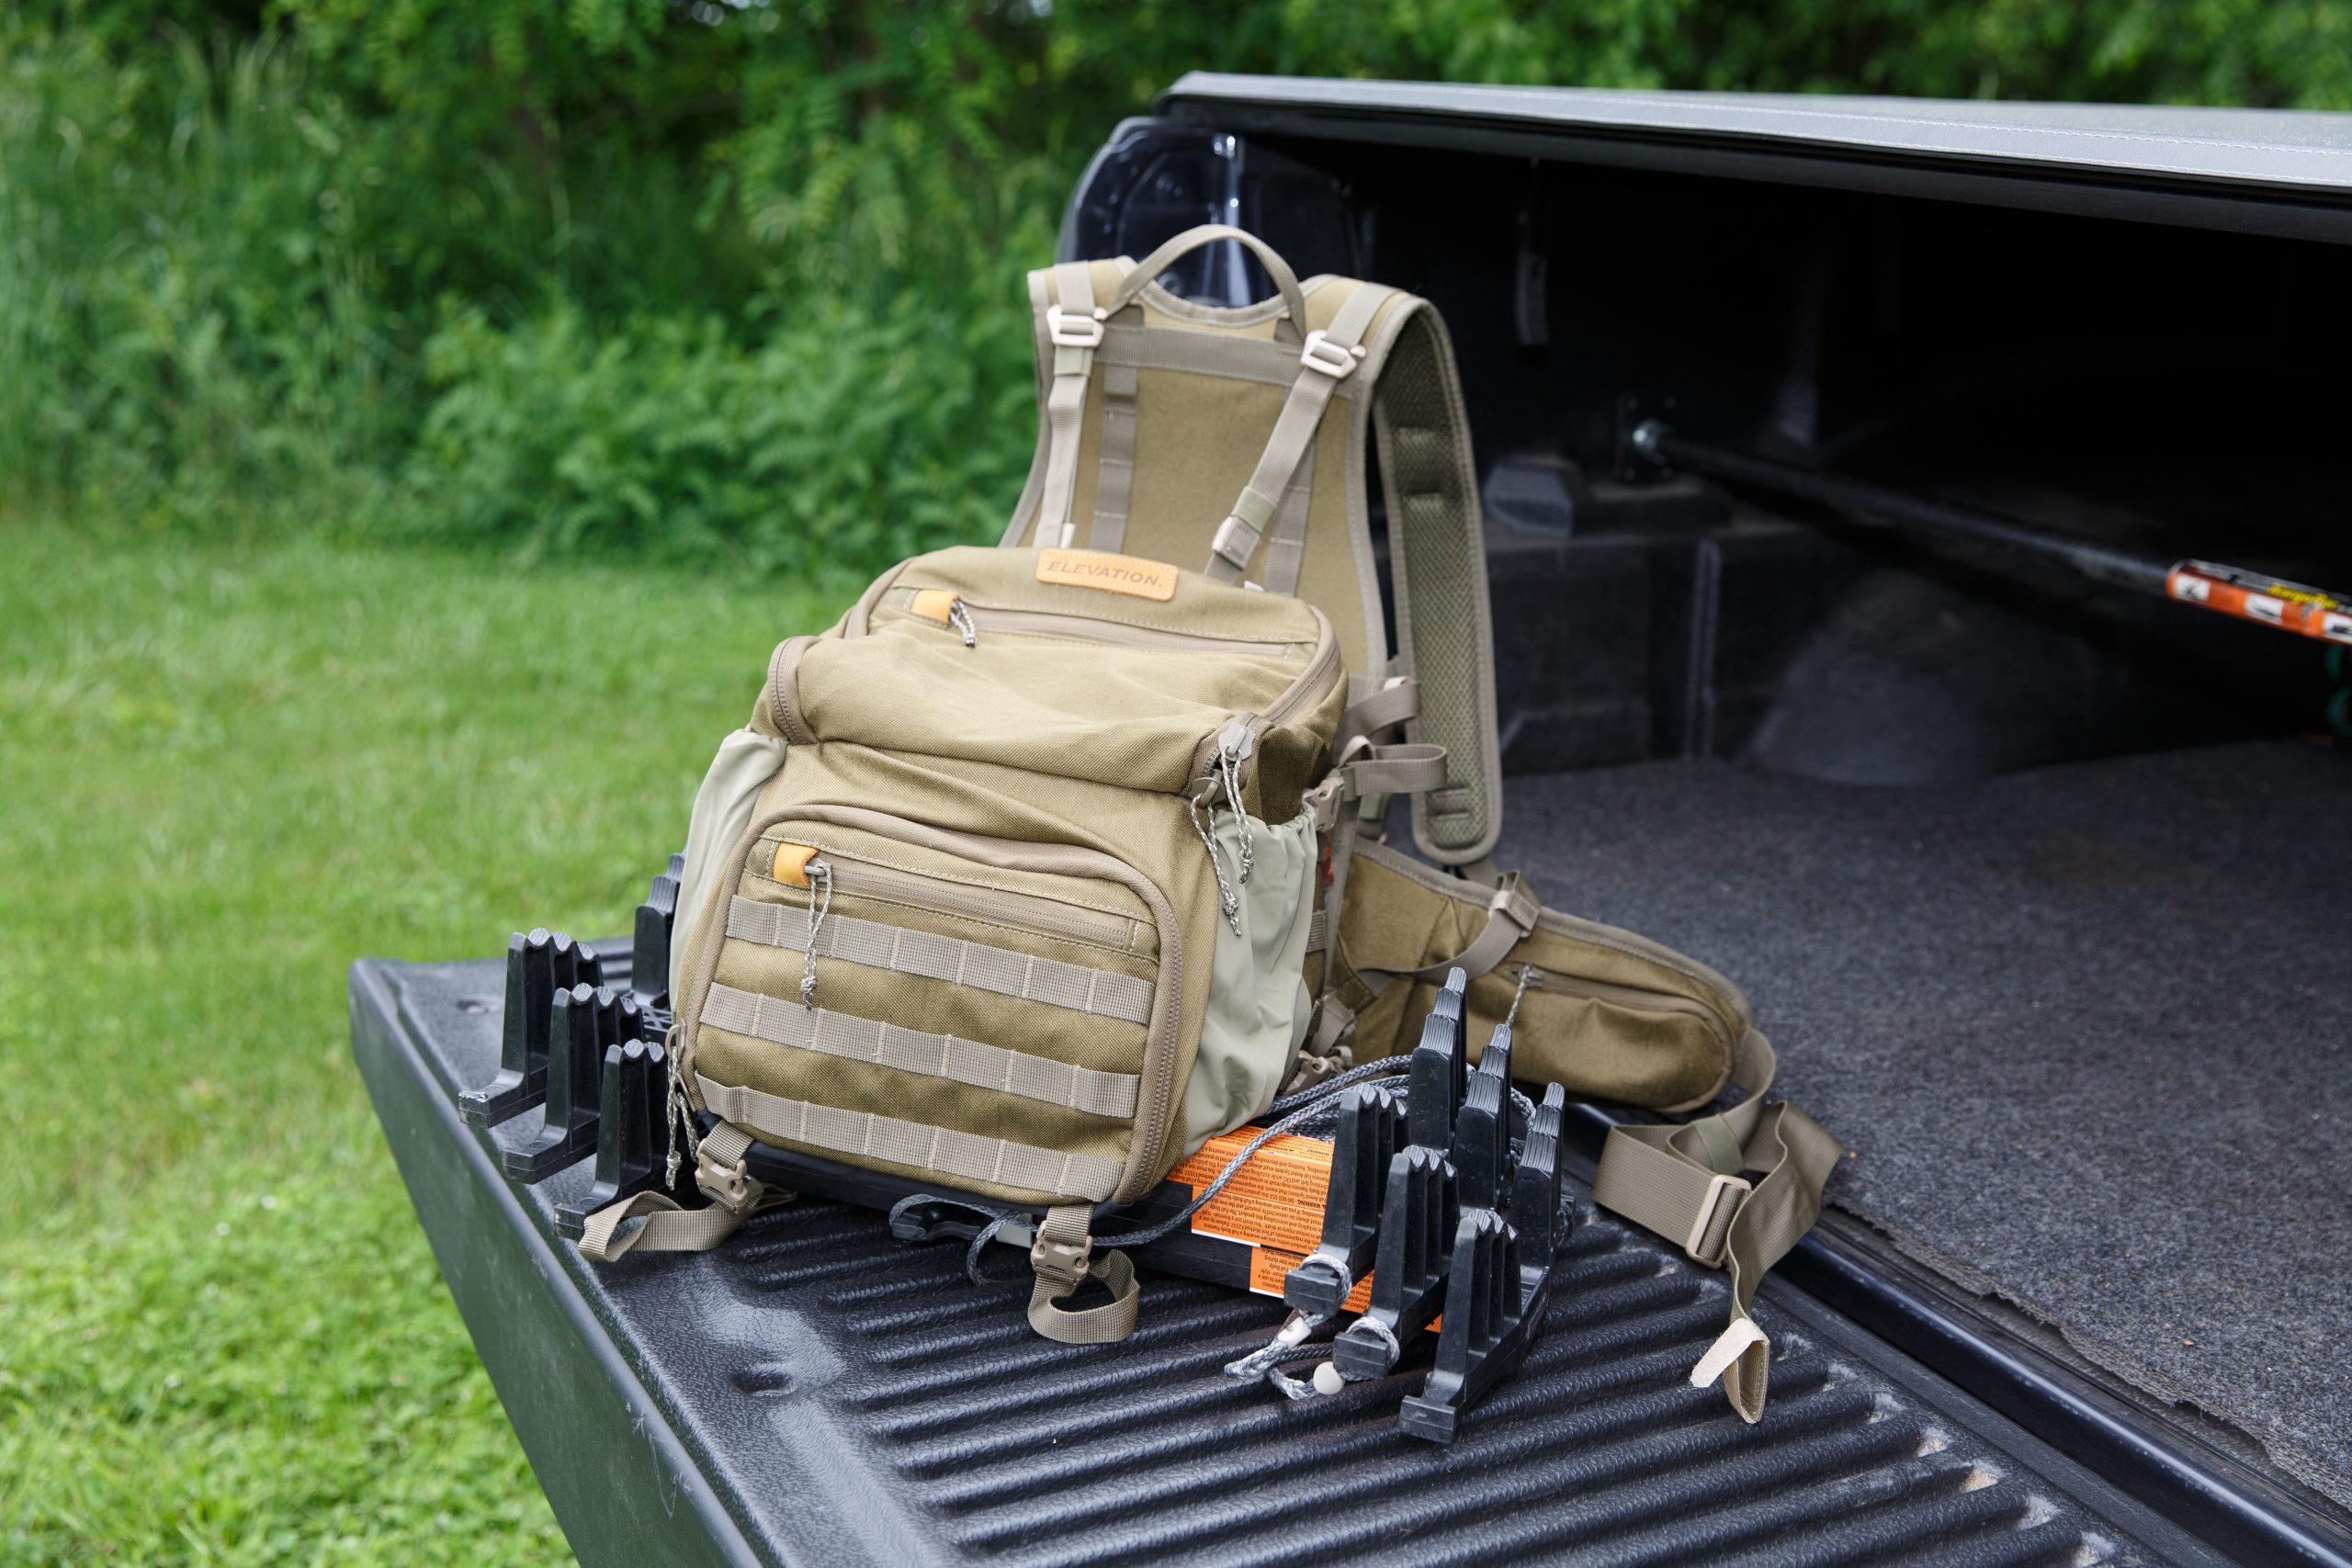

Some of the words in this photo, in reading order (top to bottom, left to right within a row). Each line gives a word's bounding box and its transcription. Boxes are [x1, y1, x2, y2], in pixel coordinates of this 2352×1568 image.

[1207, 1146, 1225, 1155] wearing
[1248, 1161, 1262, 1169] always
[1286, 1162, 1306, 1171] hunting
[1250, 1168, 1270, 1178] installing
[1290, 1184, 1308, 1192] Harness
[1231, 1194, 1243, 1202] Body
[1254, 1199, 1272, 1207] wearing
[1297, 1199, 1321, 1208] WARNING
[1262, 1214, 1288, 1224] uninstalling
[1295, 1214, 1309, 1223] always
[1219, 1225, 1230, 1234] Body
[1281, 1225, 1295, 1235] injury
[1297, 1222, 1317, 1232] installing
[1242, 1230, 1260, 1239] wearing
[1274, 1232, 1303, 1242] requirements
[1268, 1262, 1280, 1270] Body
